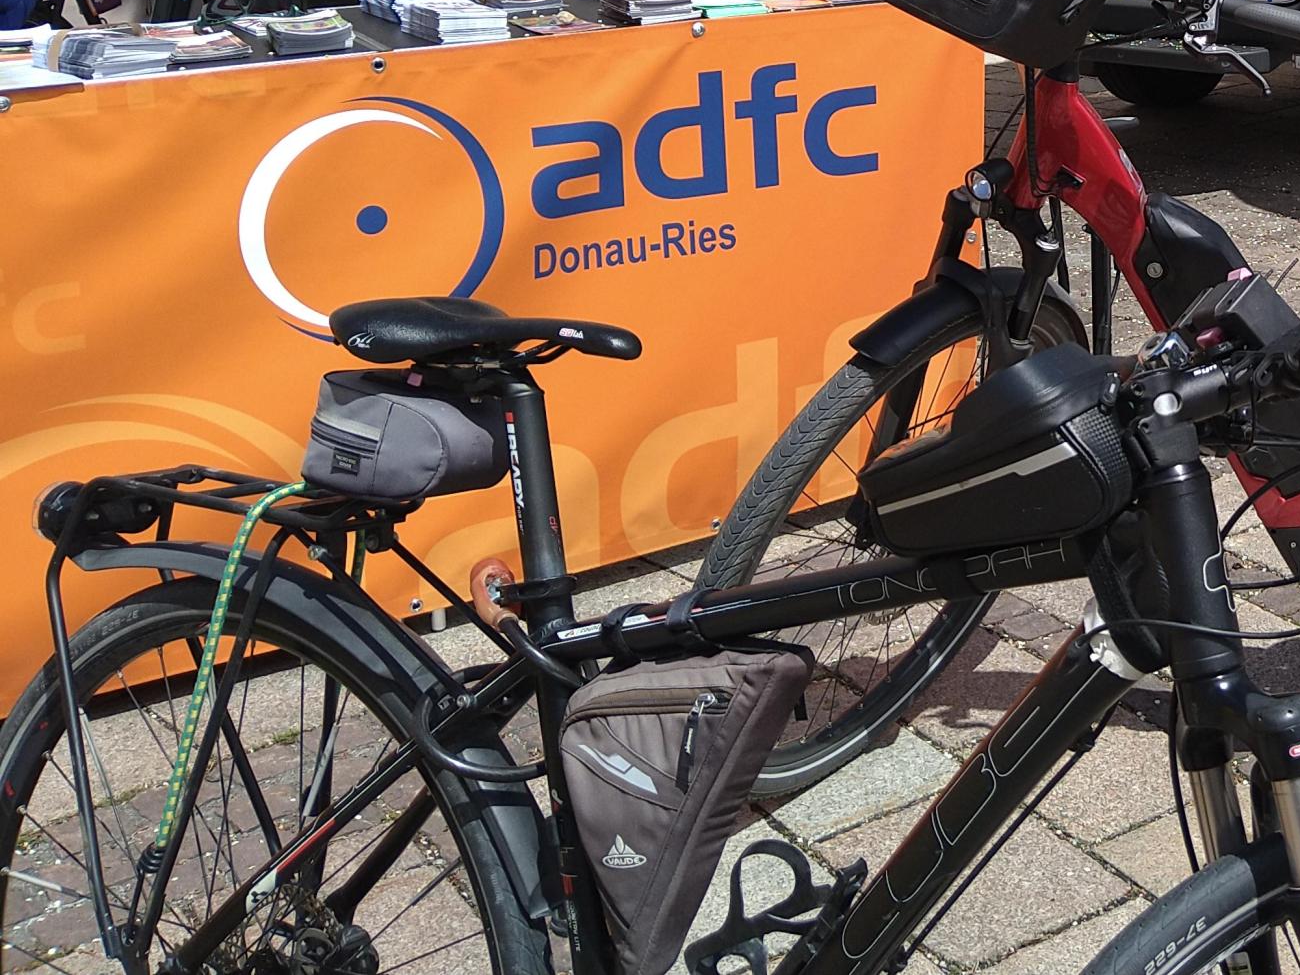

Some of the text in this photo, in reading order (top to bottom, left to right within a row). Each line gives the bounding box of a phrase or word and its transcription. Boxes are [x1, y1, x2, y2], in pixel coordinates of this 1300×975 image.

[530, 62, 879, 220] adfc
[533, 219, 737, 280] Donau-Ries
[829, 536, 1068, 609] TONPAH
[608, 856, 640, 865] VAUDE
[1143, 915, 1207, 971] 37-622
